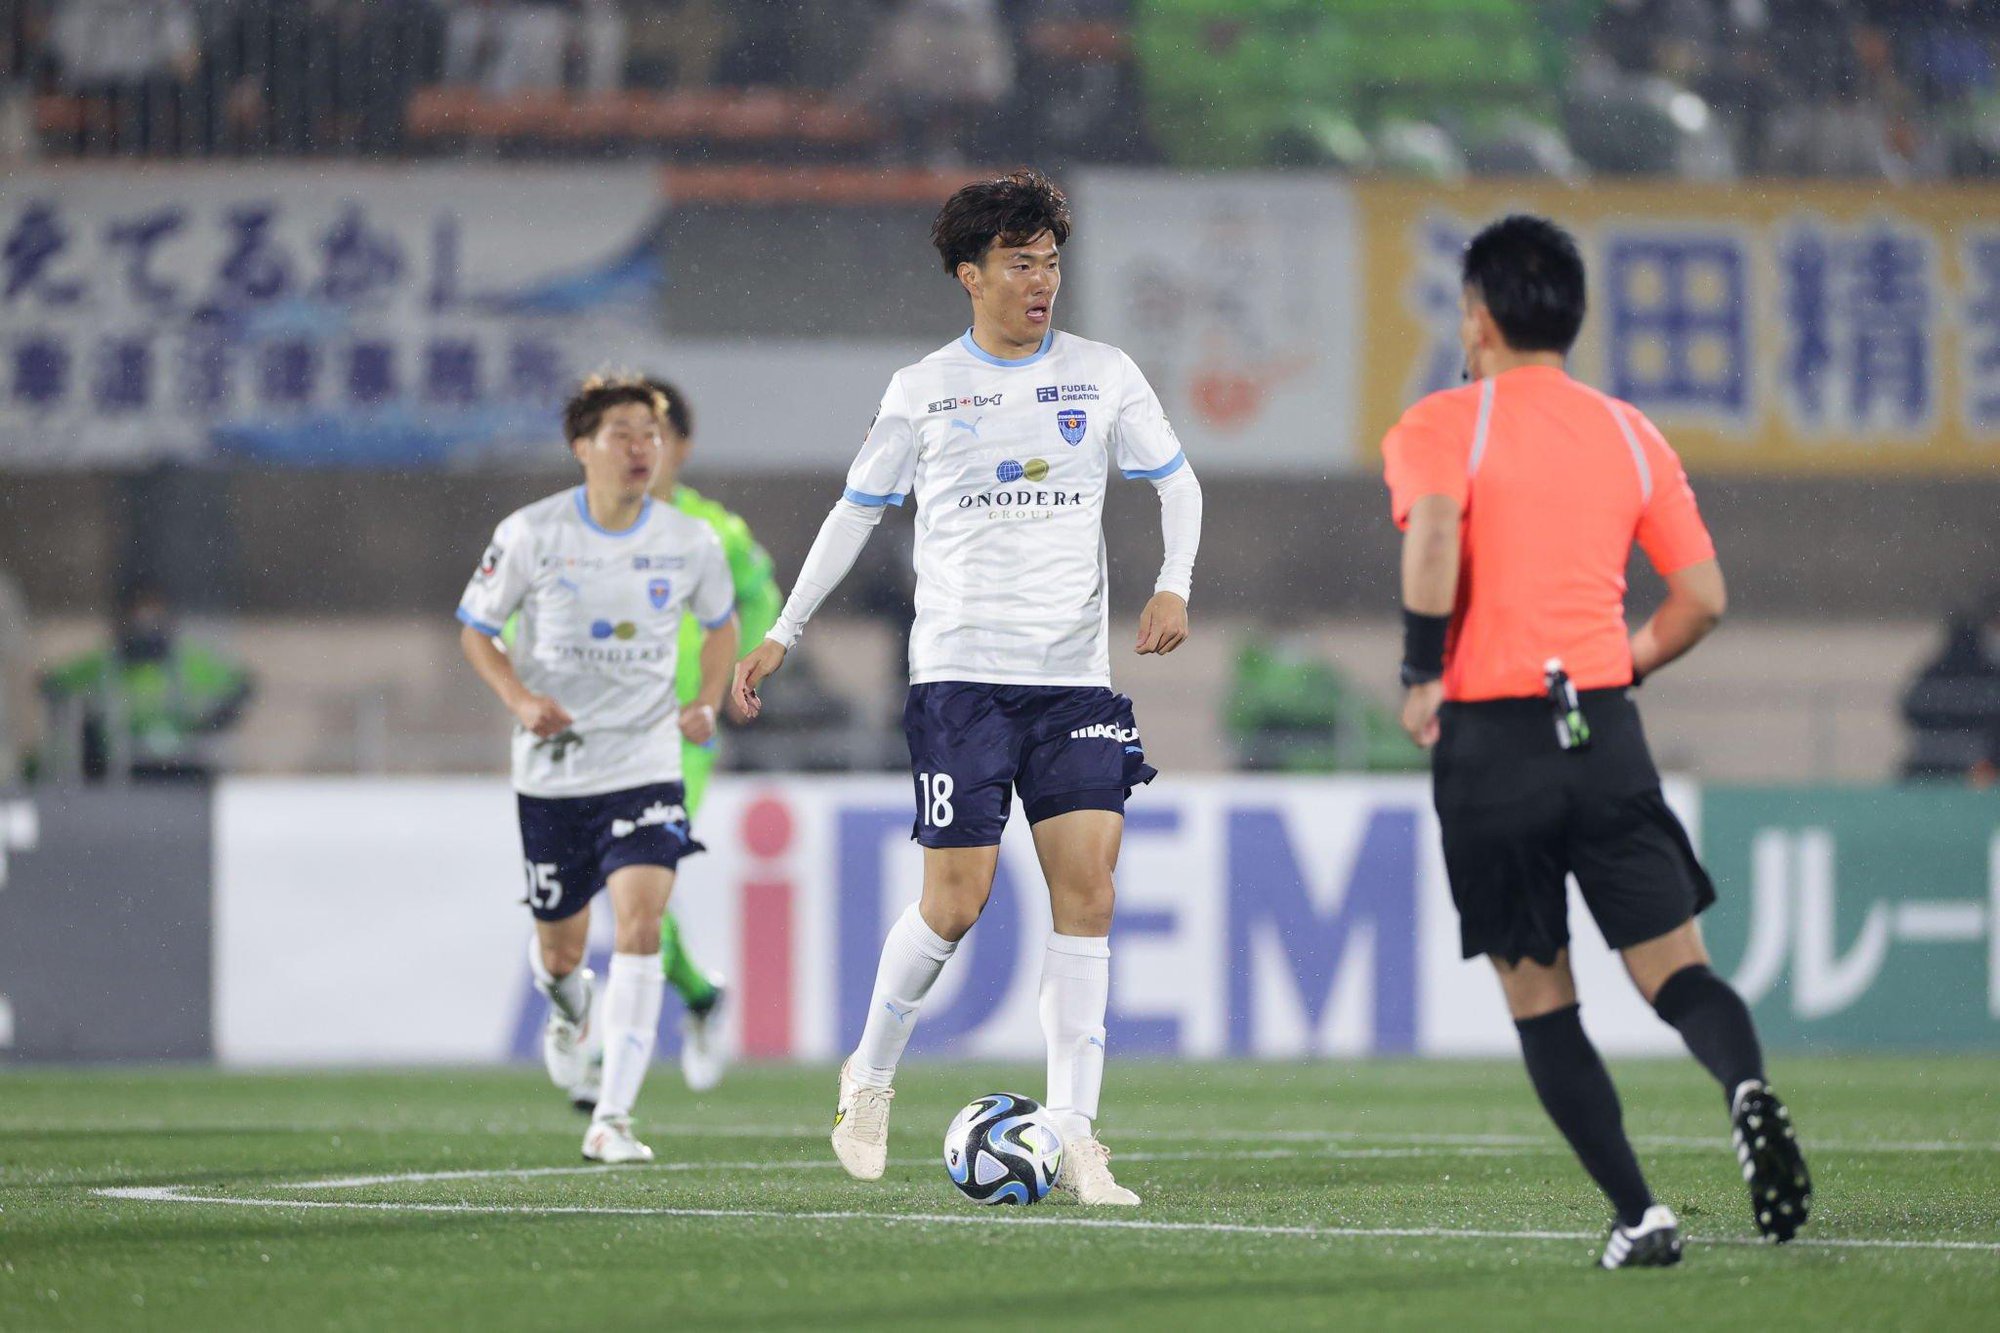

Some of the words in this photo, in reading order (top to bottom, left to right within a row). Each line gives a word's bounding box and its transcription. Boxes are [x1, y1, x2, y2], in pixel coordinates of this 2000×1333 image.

[1061, 384, 1099, 393] FUDEAL
[1061, 393, 1100, 401] CREATION
[959, 491, 1082, 508] ONODERA
[988, 509, 1054, 519] GROUP
[919, 772, 955, 828] 18
[1728, 824, 2000, 1018] ルー
